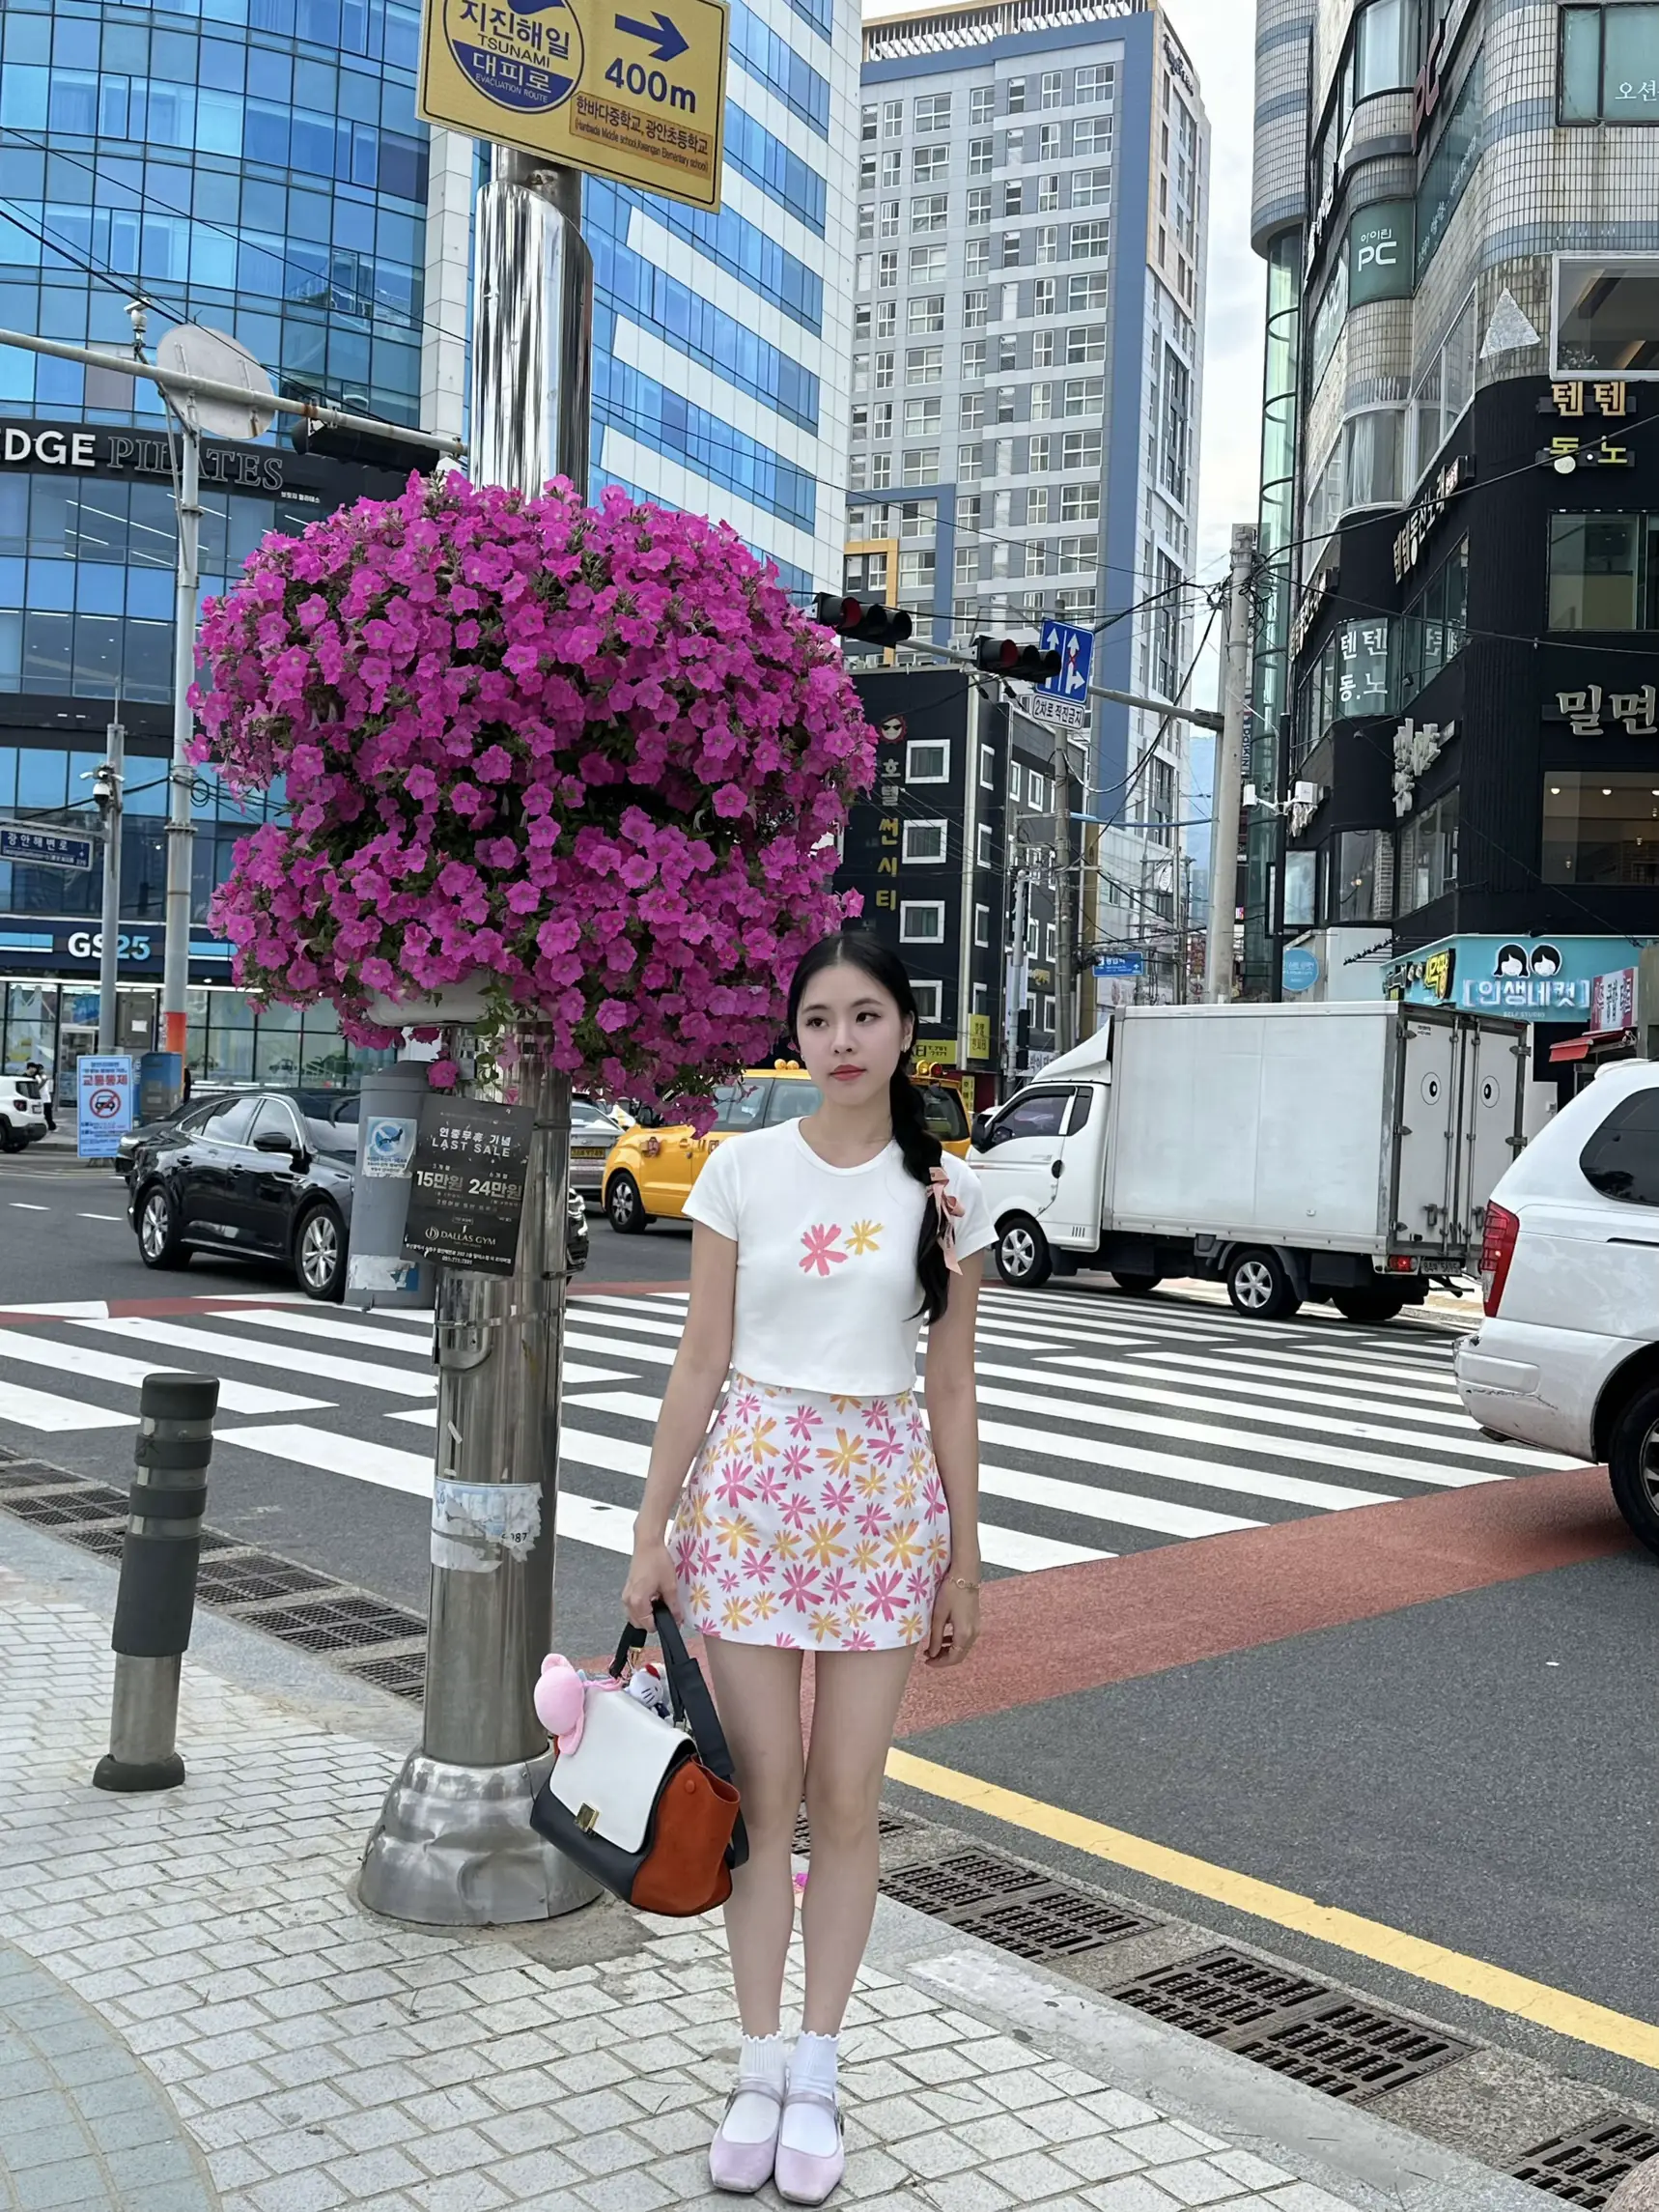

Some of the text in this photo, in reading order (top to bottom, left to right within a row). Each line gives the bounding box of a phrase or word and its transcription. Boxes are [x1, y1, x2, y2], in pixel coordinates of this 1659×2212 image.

[460, 0, 570, 60] 지진해일
[477, 33, 549, 68] TSUNAMI
[473, 52, 551, 93] 대피로
[475, 72, 548, 103] EVACUATION ROUTE
[604, 57, 696, 114] 400m
[1615, 79, 1659, 101] 오션
[645, 119, 708, 156] 광안초등학교
[1358, 241, 1397, 271] PC
[0, 428, 96, 467] DGE
[1340, 628, 1388, 661] 텐텐
[1055, 705, 1082, 726] 직진금지
[1555, 684, 1658, 736] 밀면
[8, 832, 69, 851] 광안해변로
[68, 932, 151, 960] GS25
[432, 1137, 510, 1157] LAST SALE
[439, 1127, 511, 1147] 연중무휴 기념
[416, 1171, 464, 1192] 15만원
[468, 1178, 521, 1201] 24만원
[440, 1231, 473, 1242] DALLAS
[475, 1235, 496, 1245] GYM
